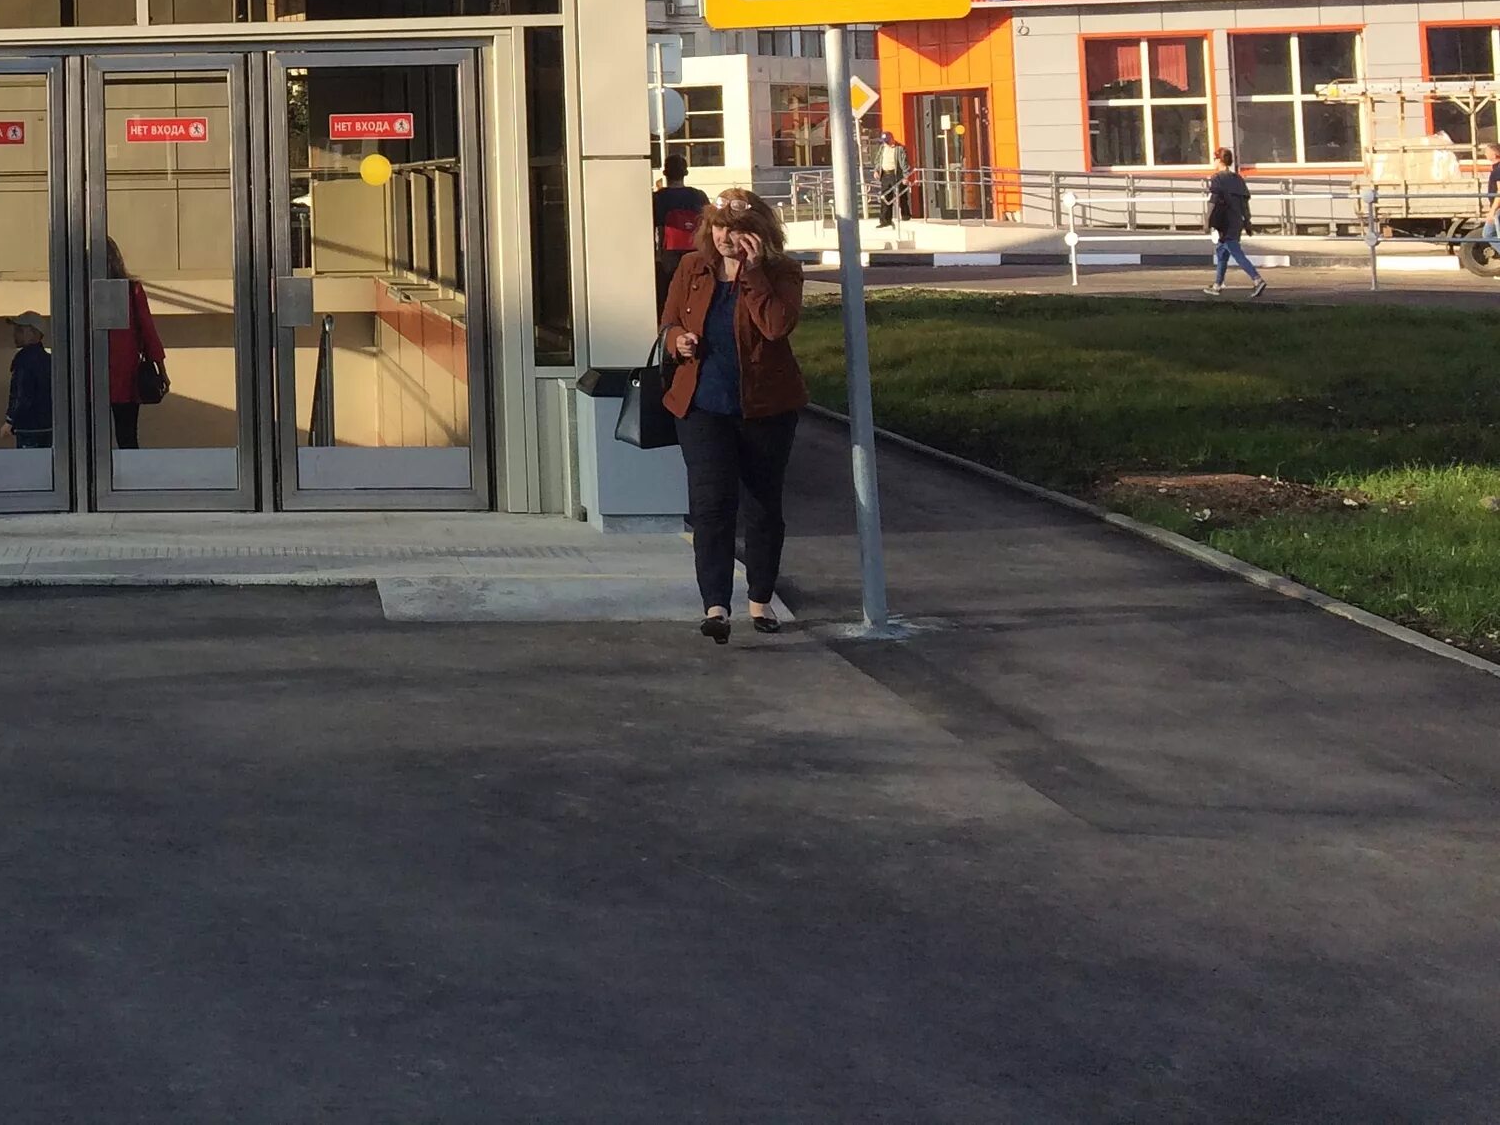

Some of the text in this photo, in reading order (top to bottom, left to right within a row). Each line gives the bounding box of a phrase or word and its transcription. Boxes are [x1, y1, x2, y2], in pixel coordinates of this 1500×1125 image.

[130, 125, 185, 136] НЕТ ВХОДА
[334, 121, 390, 133] НЕТ ВХОДА
